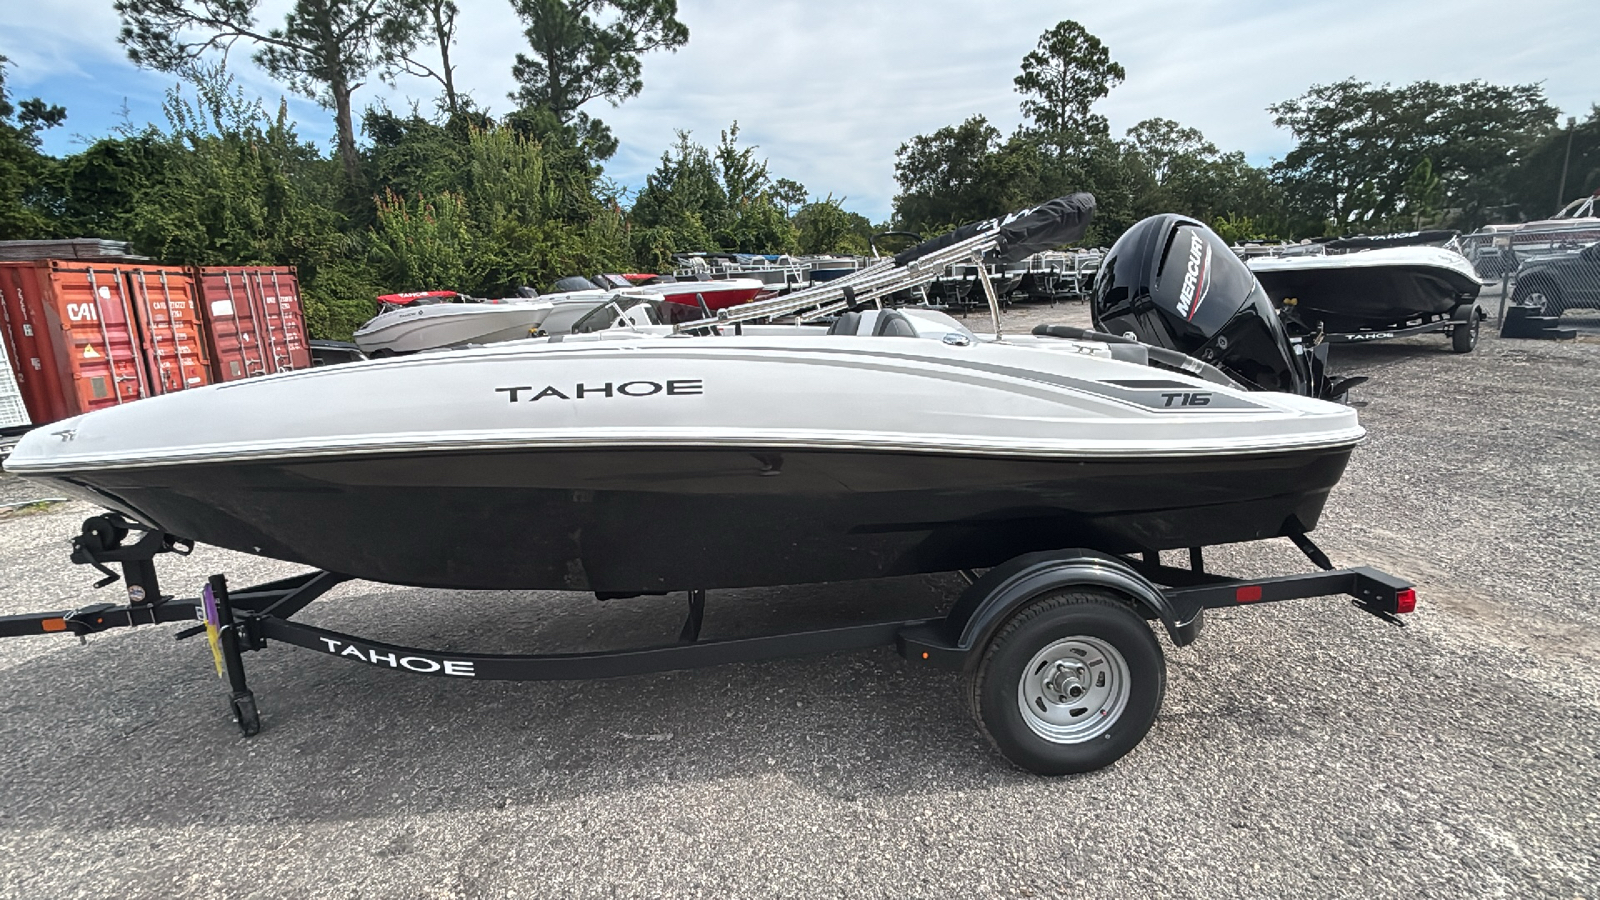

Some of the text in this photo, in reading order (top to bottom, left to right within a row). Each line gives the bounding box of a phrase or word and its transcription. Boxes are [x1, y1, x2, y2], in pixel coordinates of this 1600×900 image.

[1367, 231, 1420, 241] TAHOE
[1176, 230, 1203, 317] MERCURY
[67, 303, 98, 321] CAI
[1345, 332, 1394, 340] TAHOE
[495, 379, 703, 402] TAHOE
[1161, 393, 1212, 407] T16
[319, 637, 476, 676] TAHOE
